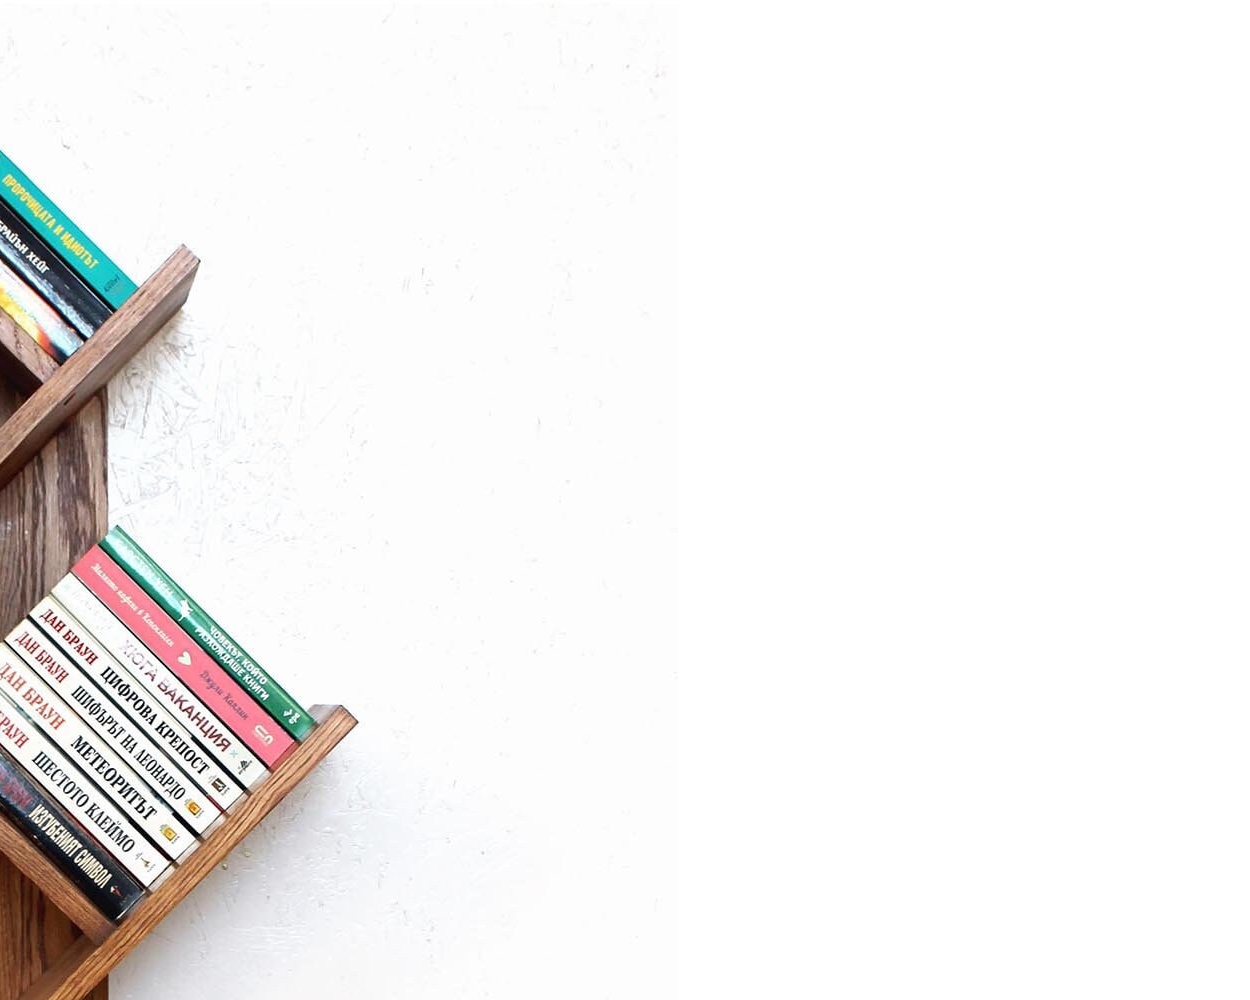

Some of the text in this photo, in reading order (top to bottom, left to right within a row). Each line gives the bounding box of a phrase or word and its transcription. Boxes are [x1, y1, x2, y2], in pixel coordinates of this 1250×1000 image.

[0, 172, 99, 271] ПРОРОЧИЦАТА И ИДИОТЪТ
[24, 249, 51, 276] ХЕЙГ
[12, 628, 70, 685] ДАН БРАУН
[37, 606, 67, 636] ДАН
[60, 627, 99, 667] БРАУН
[192, 624, 271, 702] РАЗХОЖДАШЕ КНИГИ
[205, 624, 270, 686] ЧОВЕКЪТ, КОЙТО
[20, 685, 67, 732] БРАУН
[68, 683, 128, 742] ШИФЪРЪТ
[118, 733, 140, 754] НА
[130, 746, 188, 804] ЛЕОНАРДО
[96, 663, 211, 777] ЦИФРОВА КРЕПОСТ
[154, 676, 233, 755] ВАКАНЦИЯ
[30, 748, 92, 810] ШЕСТОТО
[83, 798, 140, 855] КЛЕЙМО
[68, 733, 158, 823] МЕТЕОРИТЪТ
[26, 802, 115, 890] ИЗГУБЕНИЯТ СИМВОЛ
